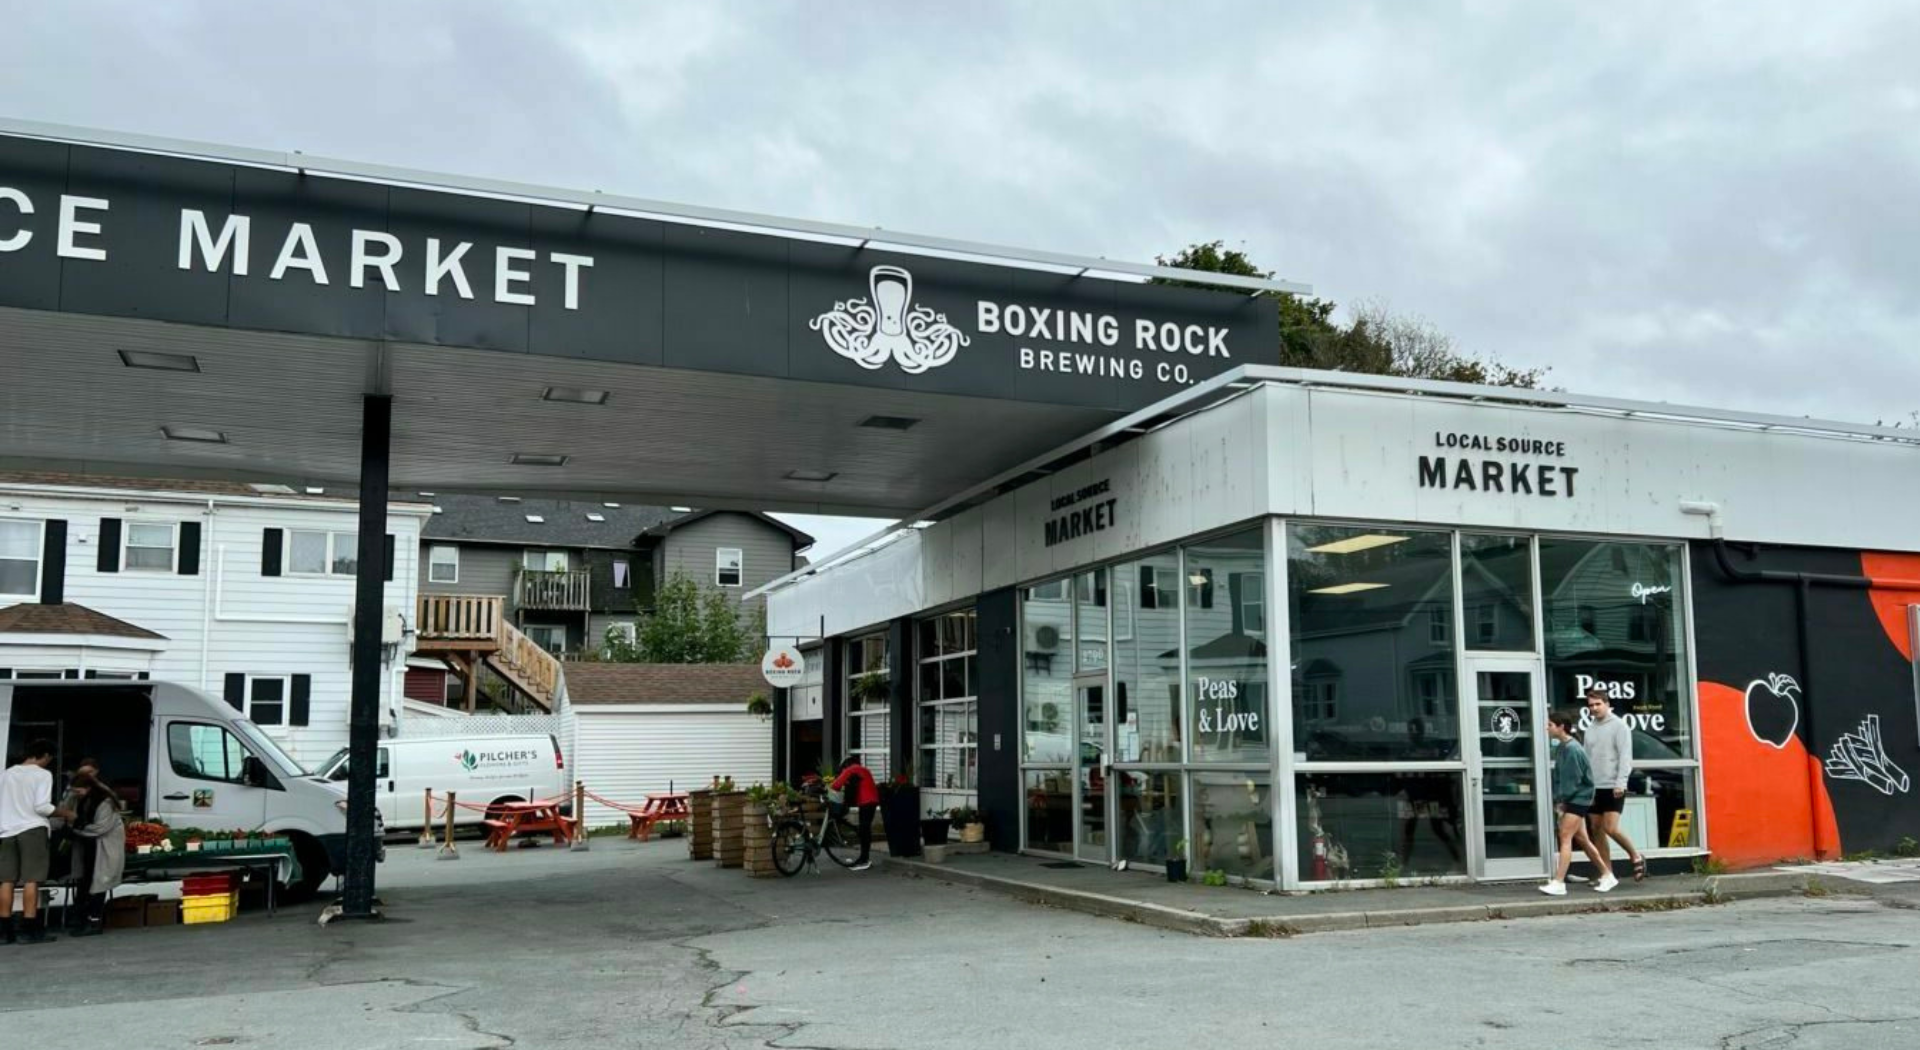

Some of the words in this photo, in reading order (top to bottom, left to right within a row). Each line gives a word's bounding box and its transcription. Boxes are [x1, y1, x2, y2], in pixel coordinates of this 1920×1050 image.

[0, 186, 110, 261] CE
[177, 208, 595, 311] MARKET
[976, 300, 1120, 347] BOXING
[1135, 318, 1232, 359] ROCK
[1019, 347, 1144, 380] BREWING
[1156, 362, 1195, 385] CO.
[1435, 431, 1492, 451] LOCAL
[1496, 436, 1566, 457] SOURCE
[1418, 455, 1579, 498] MARKET
[1051, 492, 1075, 512] LOCAL
[1076, 478, 1111, 502] SOURCE
[1044, 497, 1118, 548] MARKET
[1631, 582, 1672, 605] Open
[1198, 676, 1238, 701] Peas
[1575, 674, 1636, 699] Peas
[1198, 708, 1213, 733] &
[1215, 707, 1259, 733] Love
[1578, 706, 1595, 731] &
[1608, 707, 1665, 731] ove
[480, 750, 538, 762] PILCHER'S
